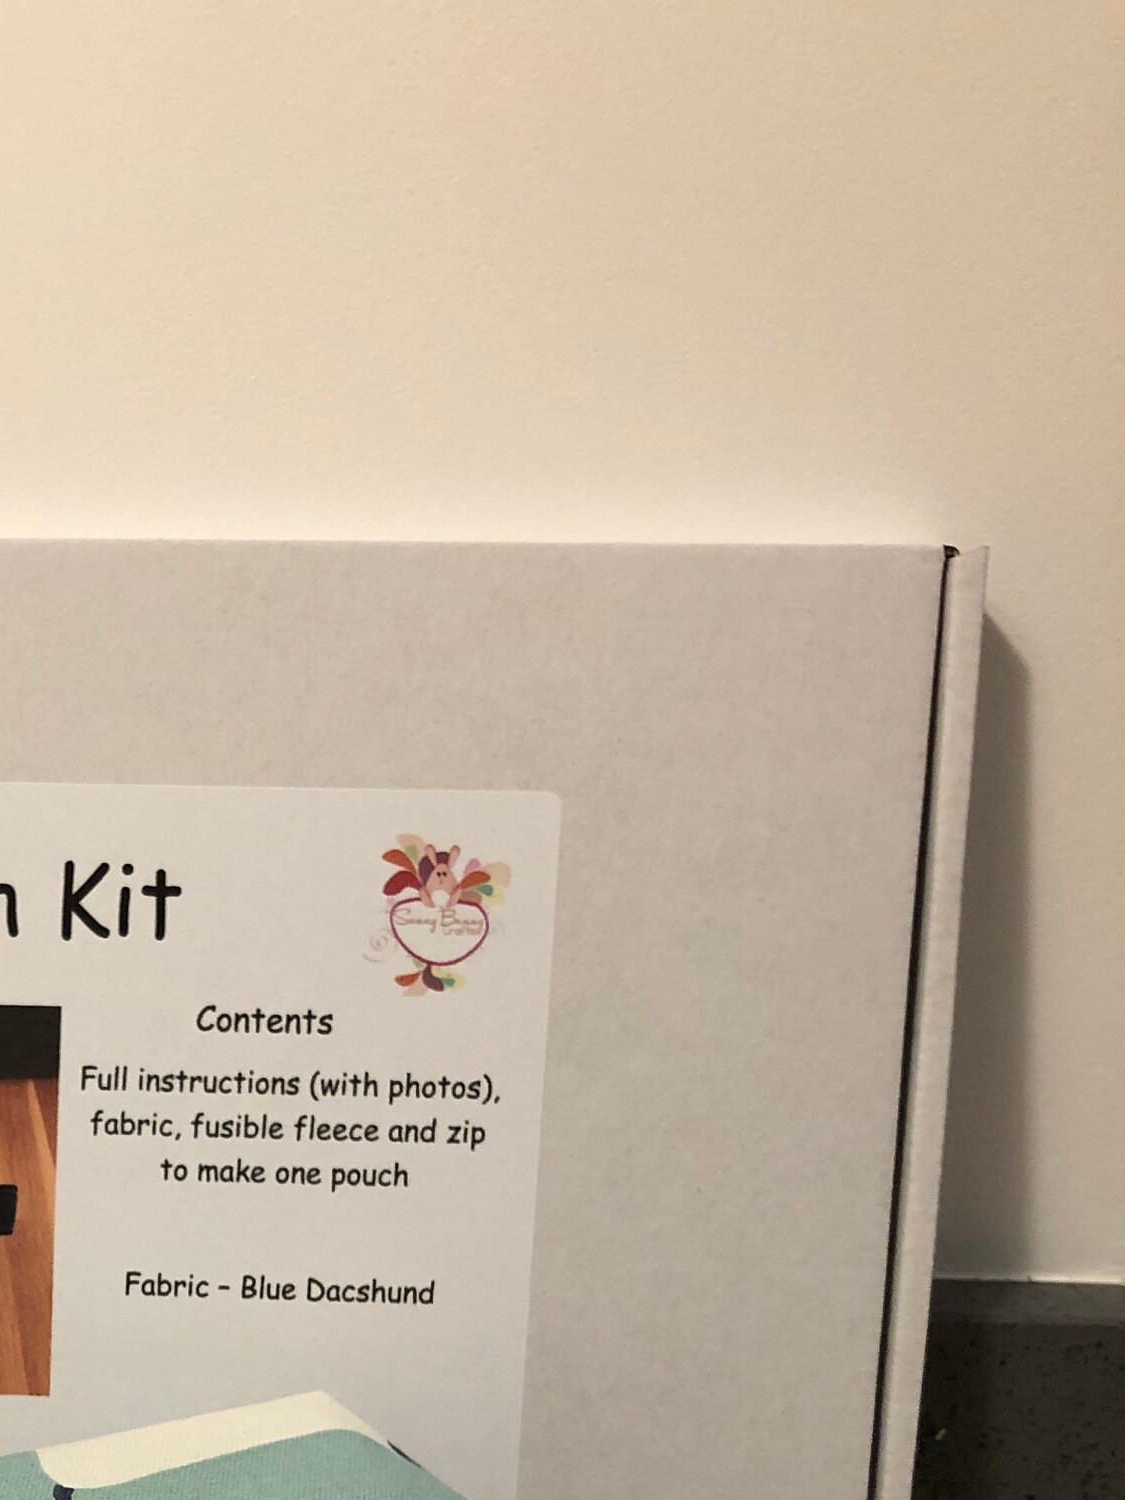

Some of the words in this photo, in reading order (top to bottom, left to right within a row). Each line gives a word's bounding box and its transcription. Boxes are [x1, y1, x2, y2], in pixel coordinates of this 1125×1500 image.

[61, 860, 182, 942] Kit
[196, 1004, 334, 1035] Contents
[81, 1065, 128, 1091] Full
[138, 1067, 300, 1096] instructions
[309, 1070, 379, 1102] (with
[388, 1072, 500, 1106] photos),
[90, 1109, 182, 1141] fabric,
[190, 1112, 284, 1140] fusible
[293, 1114, 379, 1142] fleece
[388, 1117, 437, 1144] and
[446, 1119, 486, 1152] zip
[160, 1158, 188, 1182] to
[197, 1157, 266, 1184] make
[275, 1166, 322, 1186] one
[331, 1162, 409, 1193] pouch
[125, 1271, 209, 1298] Fabric
[241, 1274, 297, 1301] Blue
[306, 1277, 436, 1305] Dacshund
